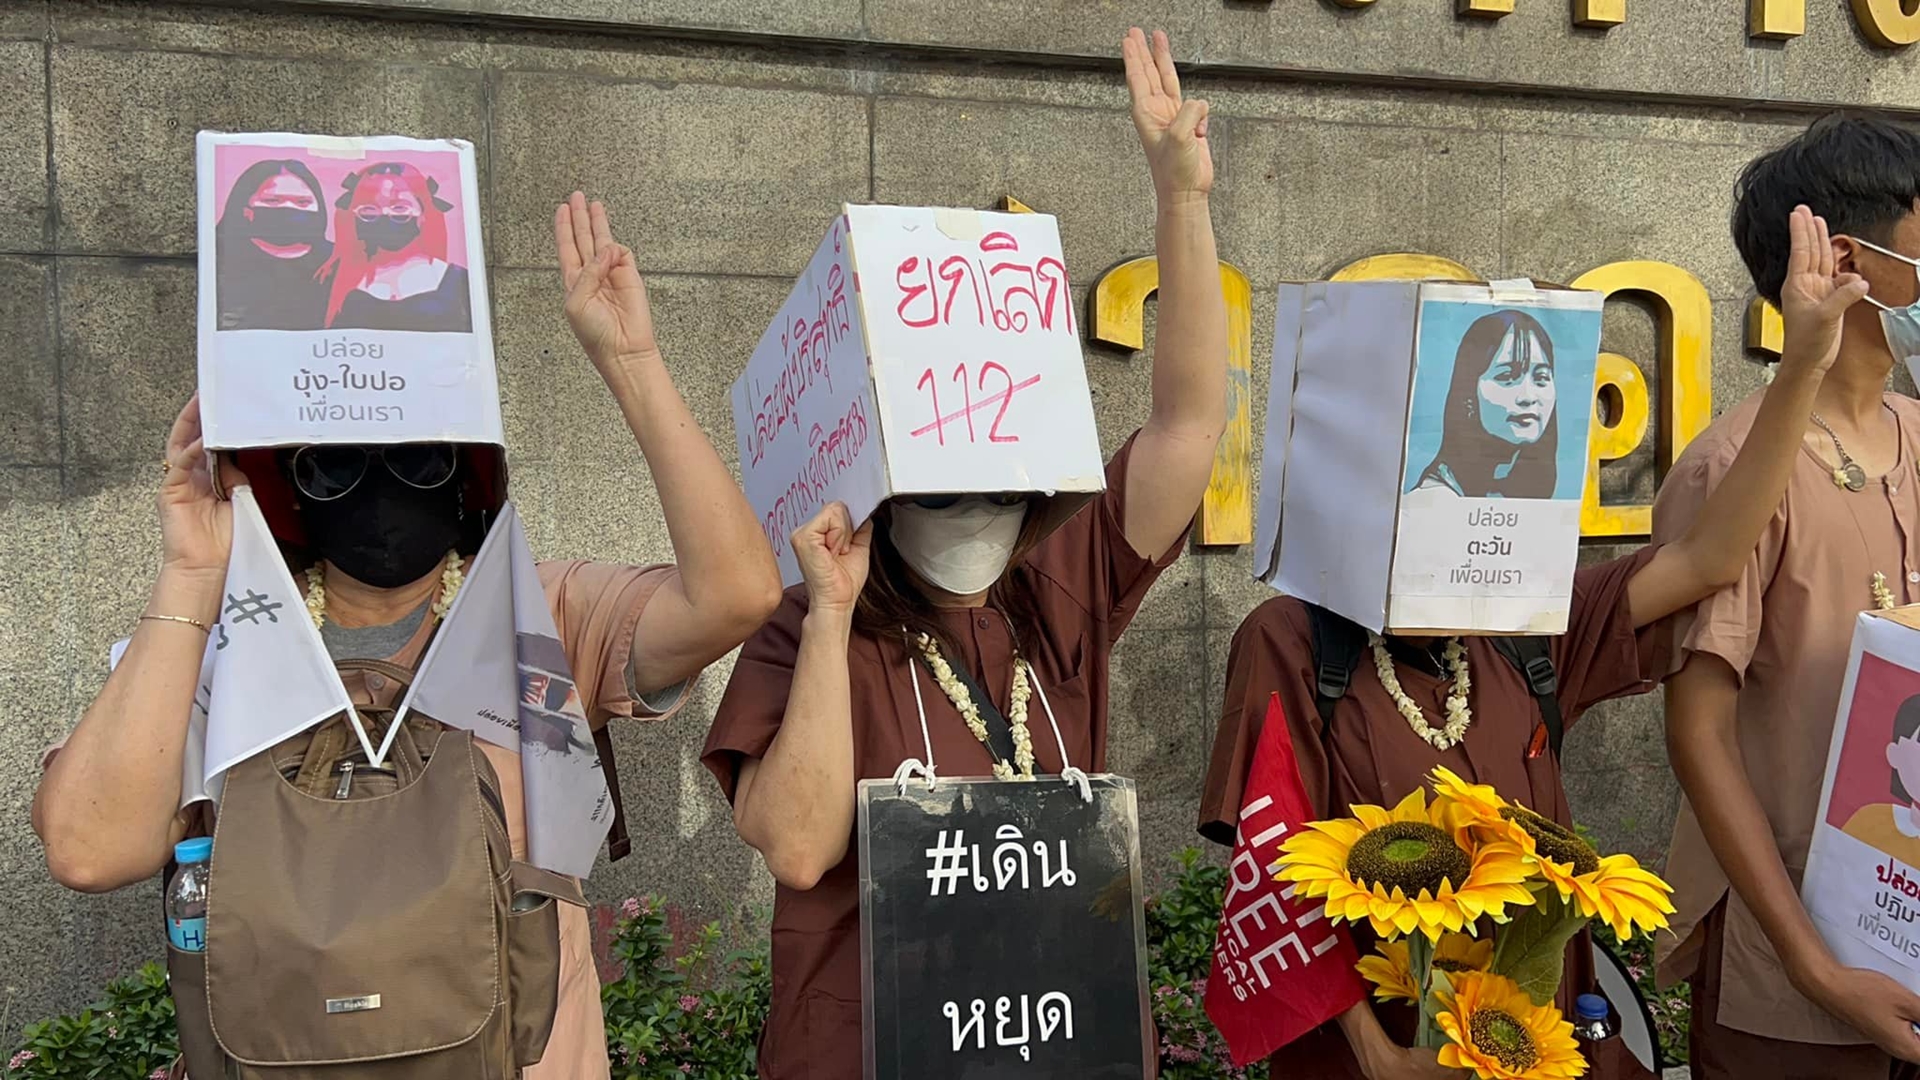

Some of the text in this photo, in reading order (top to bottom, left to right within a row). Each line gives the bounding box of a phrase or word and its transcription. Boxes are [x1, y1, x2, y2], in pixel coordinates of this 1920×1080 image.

[896, 231, 1073, 336] ยกเลิก
[312, 337, 384, 359] ปล่อย
[293, 364, 406, 398] บุ้ง-ใบปอ
[299, 395, 404, 422] เพื่อนเรา
[914, 361, 1032, 446] 112
[1468, 506, 1519, 527] ปล่อย
[1467, 535, 1512, 556] ตะวัน
[1449, 559, 1523, 585] เพื่อนเรา
[925, 824, 1077, 896] #เดิน
[1876, 857, 1920, 902] ปล่อ
[1875, 891, 1920, 923] ปฏิม
[1858, 911, 1920, 959] เพื่อนเร
[942, 991, 1074, 1062] หยุด
